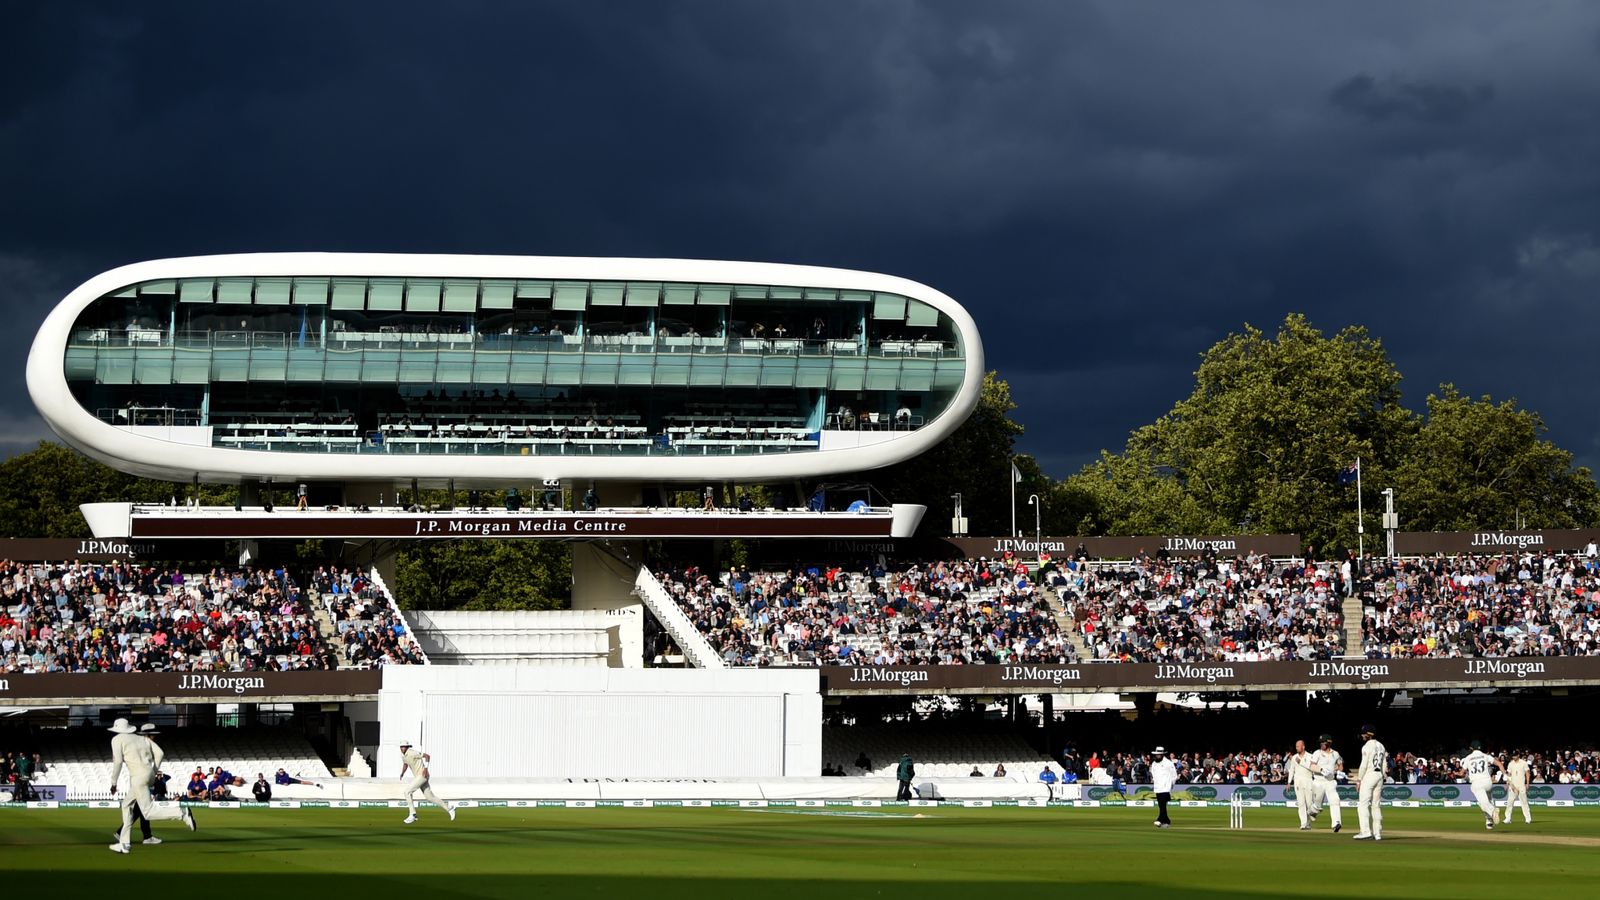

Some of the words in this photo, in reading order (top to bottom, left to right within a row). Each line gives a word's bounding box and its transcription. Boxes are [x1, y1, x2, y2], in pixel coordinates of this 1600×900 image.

[415, 520, 441, 535] J.P.
[448, 520, 511, 535] Morgan
[518, 520, 567, 531] Media
[573, 520, 627, 531] Centre
[1165, 538, 1236, 554] J.P.Mogan
[1471, 533, 1544, 548] J.P.Morgan
[849, 668, 928, 685] J.P.Morgan
[1001, 667, 1080, 684] J.P.Morgan
[1155, 665, 1234, 682] J.P.Morgan
[1309, 663, 1389, 680] J.P.Morgan
[1464, 660, 1545, 678] J.P.Morgan
[178, 675, 265, 693] J.P.Morgan
[1471, 760, 1485, 774] 33
